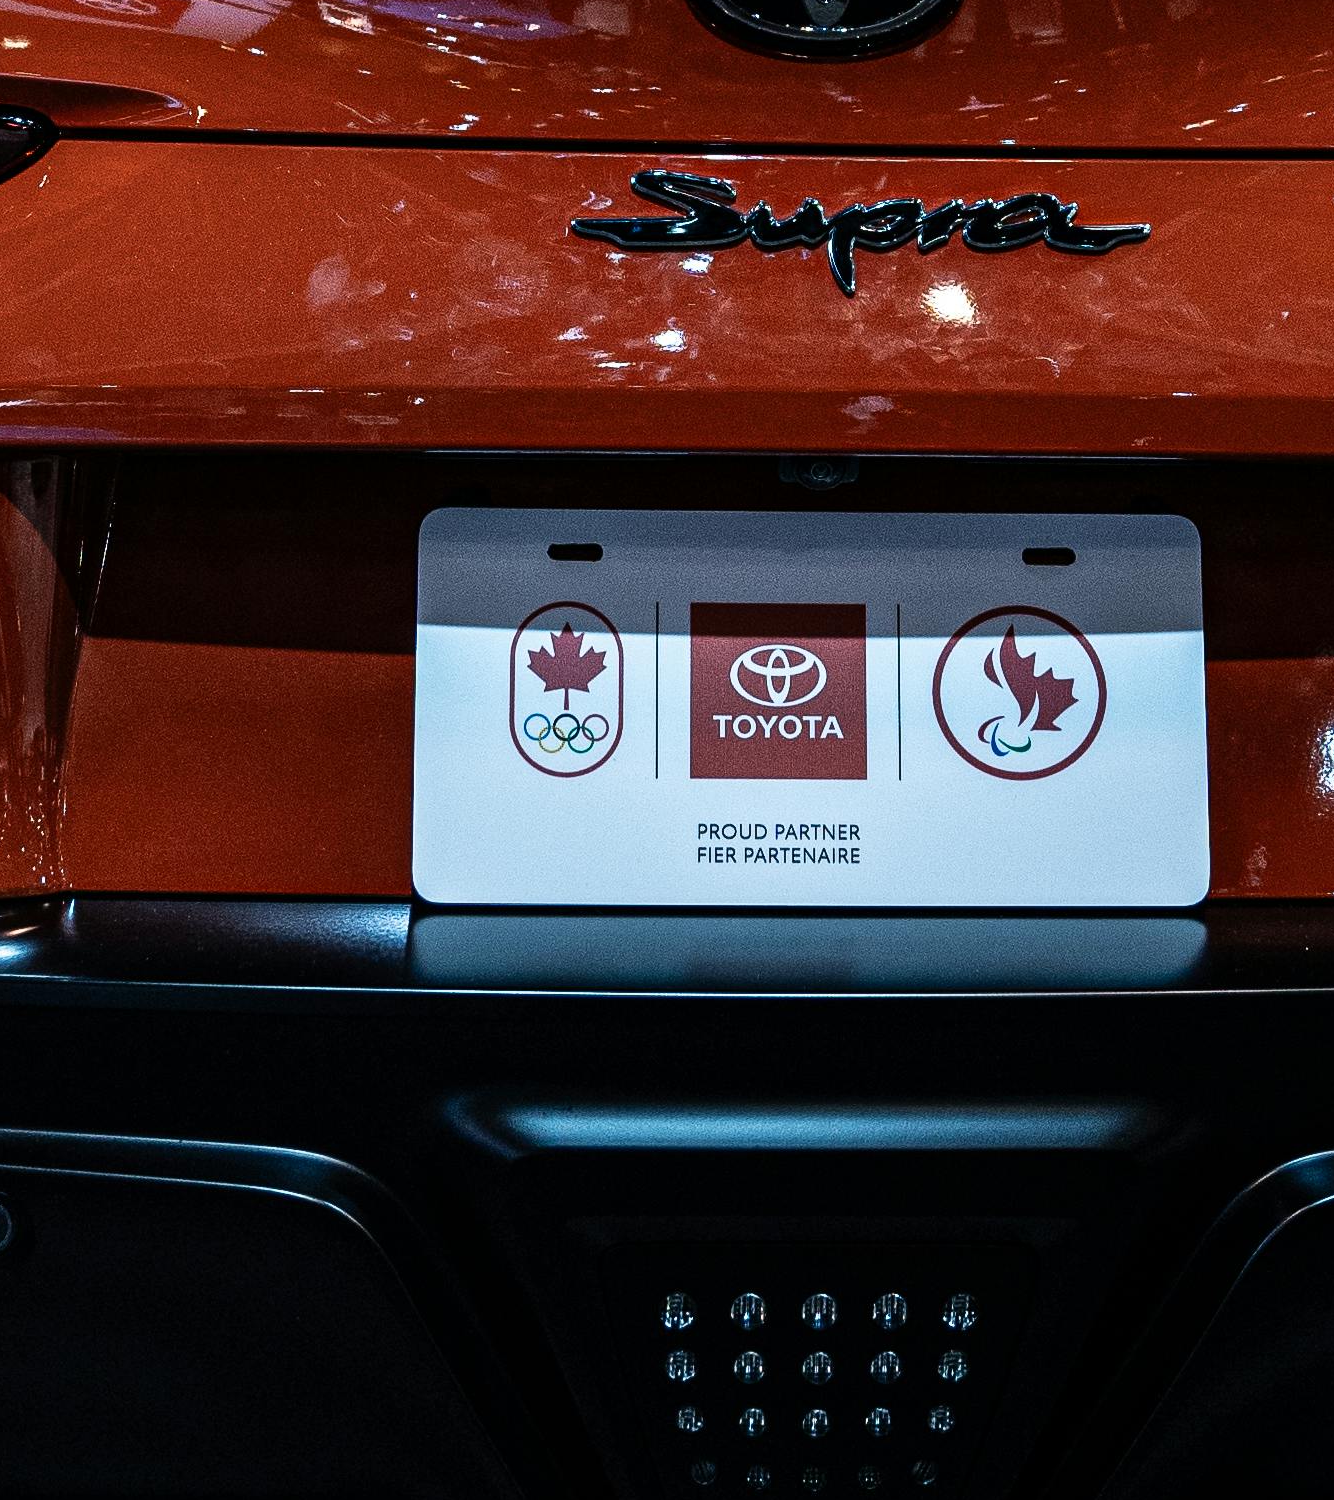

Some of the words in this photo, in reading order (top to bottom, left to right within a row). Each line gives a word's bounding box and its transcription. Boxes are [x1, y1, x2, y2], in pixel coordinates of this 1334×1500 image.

[570, 167, 1152, 298] Supra
[712, 714, 845, 740] TOYOTA
[697, 823, 768, 840] PROUD
[775, 823, 861, 841] PARTNER
[697, 847, 737, 864] FIER
[744, 847, 861, 864] PARTENAIRE
